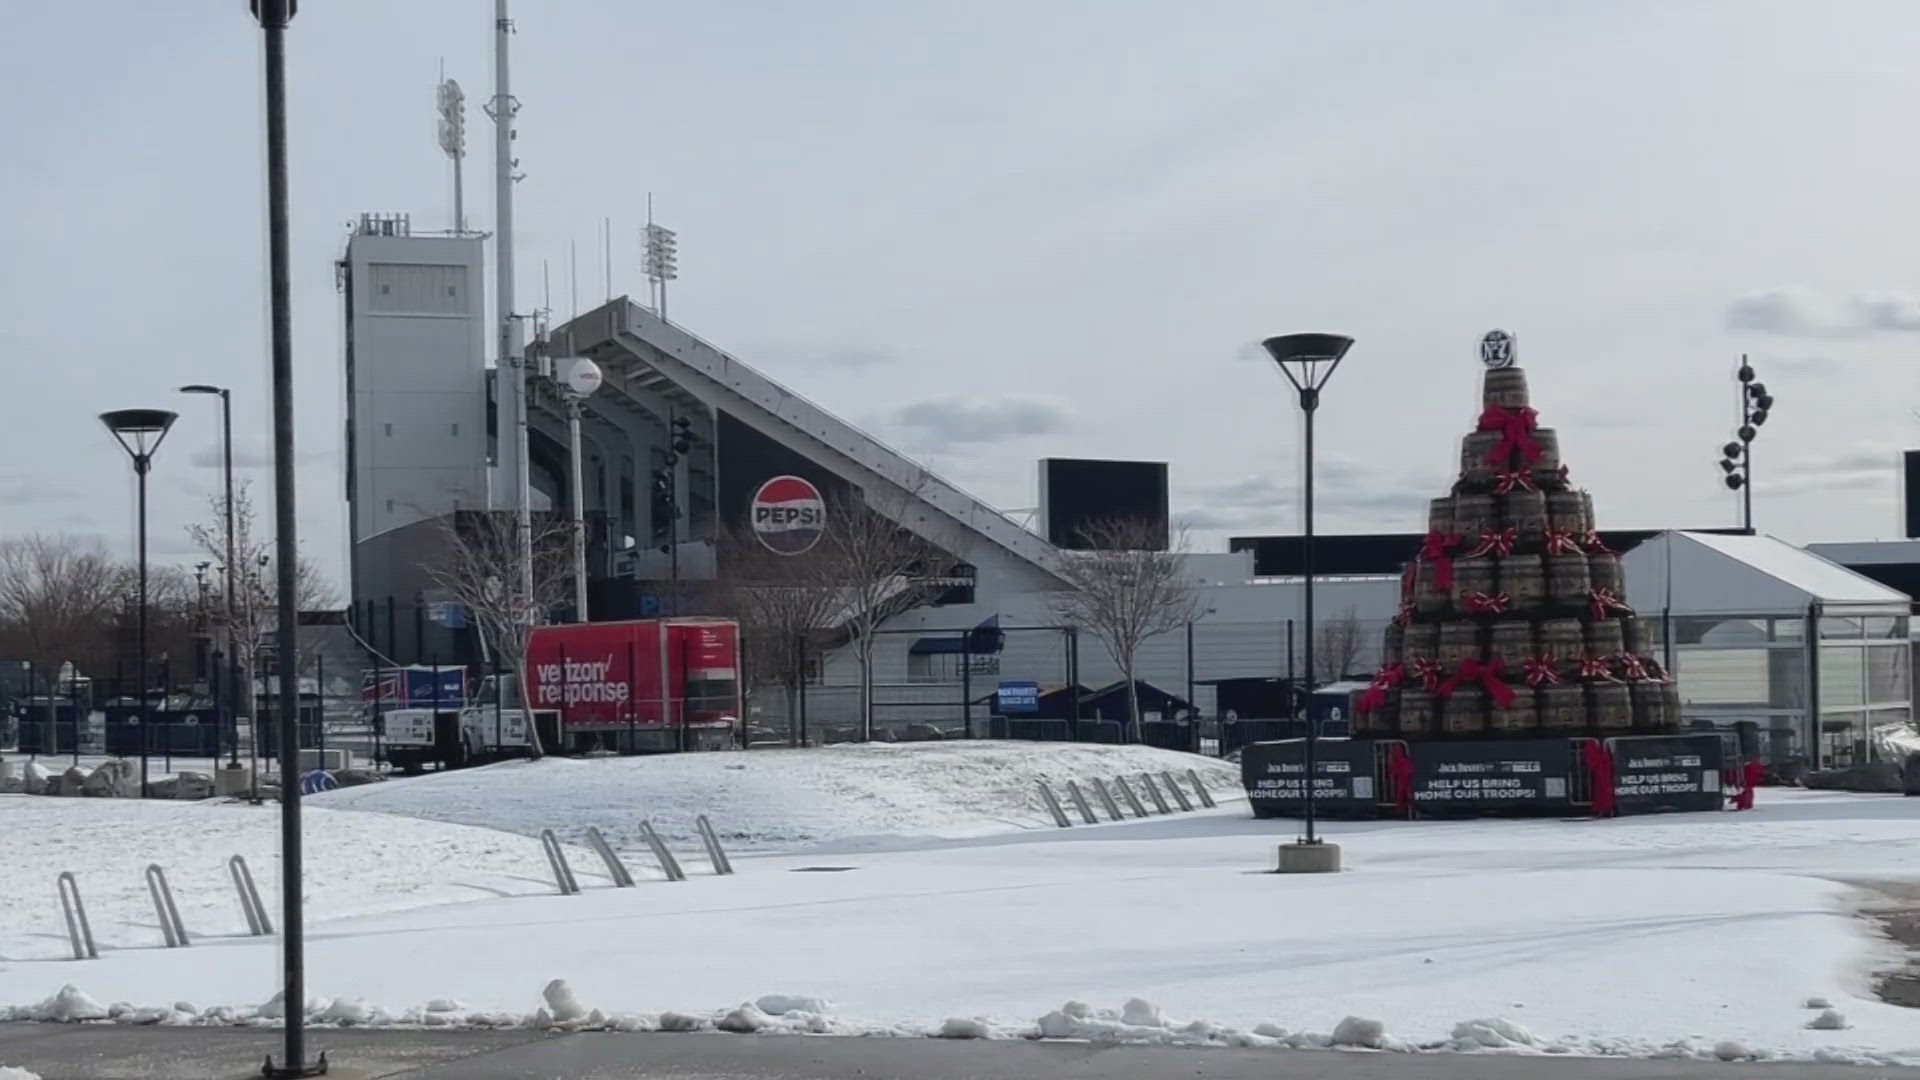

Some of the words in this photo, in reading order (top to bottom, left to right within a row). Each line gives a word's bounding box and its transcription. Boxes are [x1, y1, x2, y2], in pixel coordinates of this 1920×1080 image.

[756, 507, 821, 524] PEPSI
[537, 657, 605, 682] veizon
[1257, 779, 1285, 789] HELP
[1286, 779, 1299, 788] US
[1428, 779, 1460, 789] HELP
[1462, 779, 1479, 788] US
[1482, 779, 1521, 788] BRING
[1621, 775, 1646, 784] HELP
[1646, 774, 1660, 784] US
[1662, 773, 1688, 782] BRING
[1281, 789, 1301, 798] OUR
[1414, 790, 1452, 800] HOME
[1454, 789, 1480, 799] OUR
[1483, 788, 1536, 798] TROOPS!
[1615, 785, 1638, 796] HOME
[1640, 784, 1660, 794] OUR
